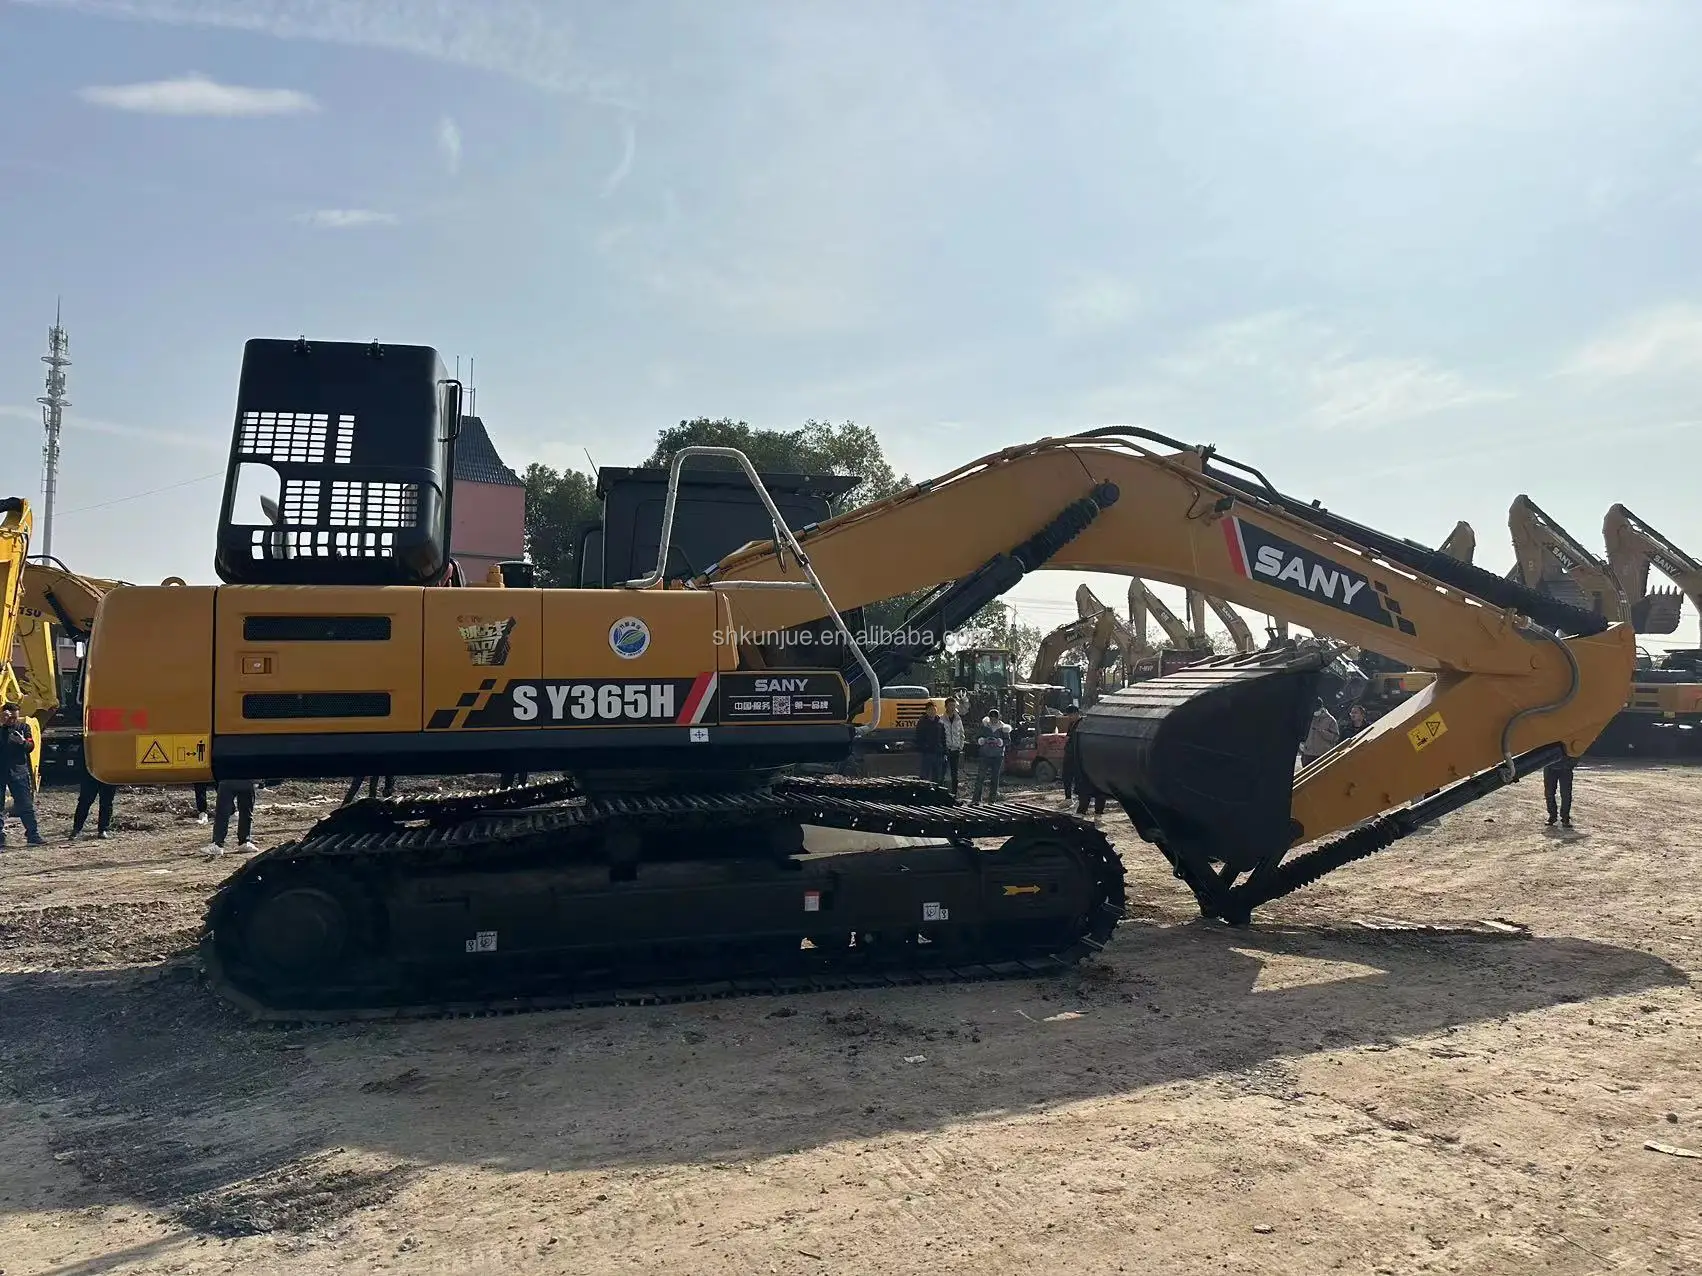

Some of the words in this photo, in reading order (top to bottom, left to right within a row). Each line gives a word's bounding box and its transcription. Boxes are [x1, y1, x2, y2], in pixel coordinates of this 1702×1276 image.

[1552, 547, 1573, 567] SANY
[1653, 554, 1677, 574] SANY
[1254, 545, 1366, 605] SANY
[754, 679, 808, 692] SANY
